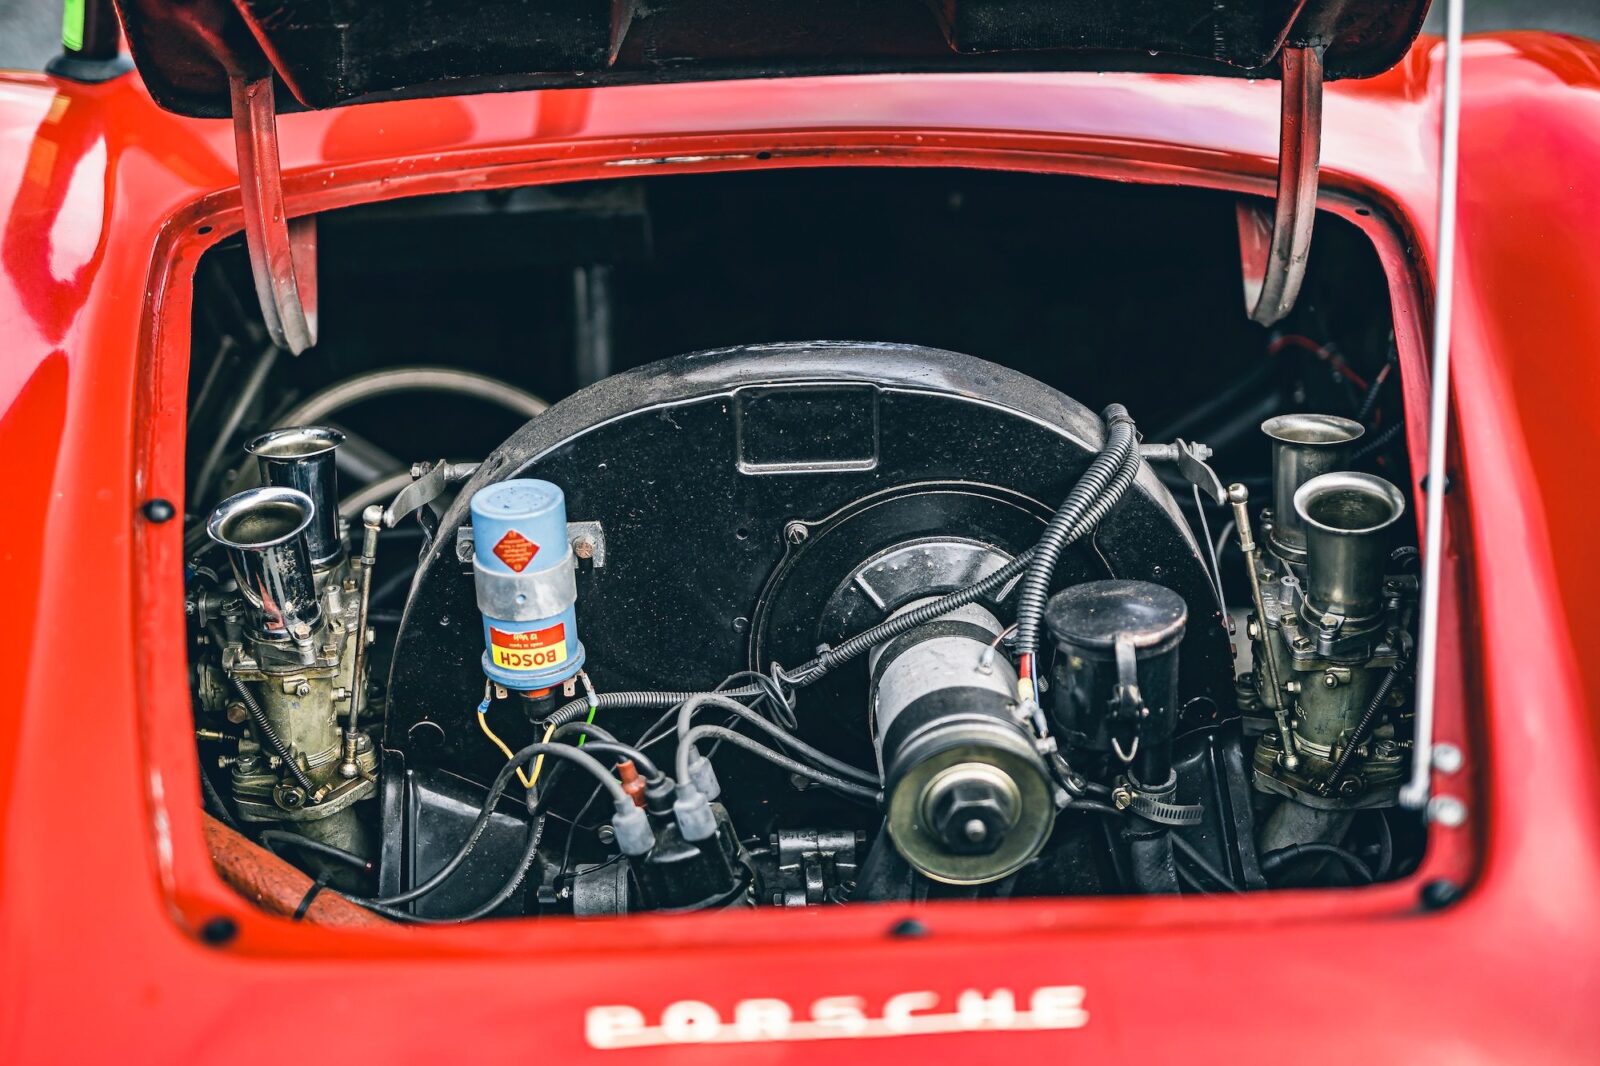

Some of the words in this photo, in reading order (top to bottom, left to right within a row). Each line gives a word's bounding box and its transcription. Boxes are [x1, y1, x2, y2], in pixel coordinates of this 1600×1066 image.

[500, 649, 556, 667] BOSCH
[524, 848, 537, 870] PLUG
[585, 985, 1089, 1049] PORSCHE
